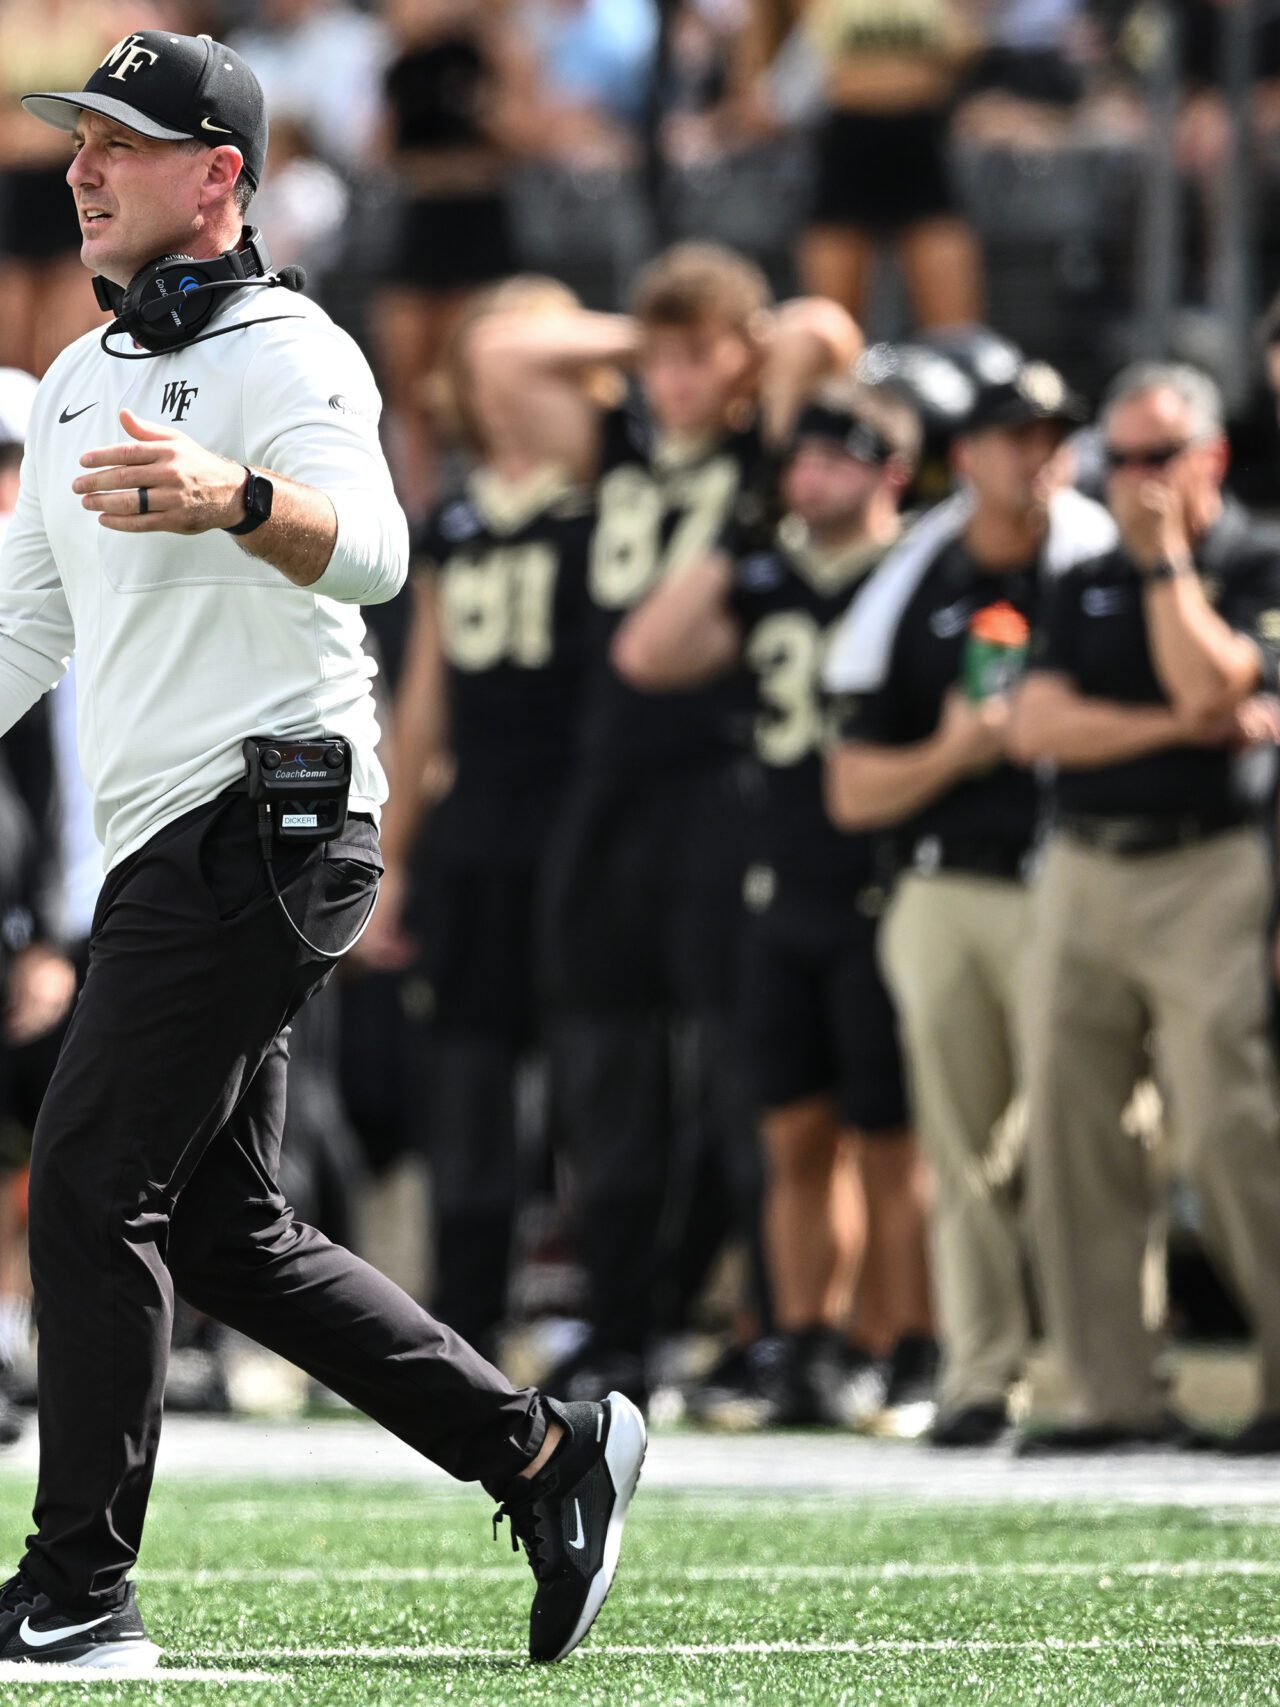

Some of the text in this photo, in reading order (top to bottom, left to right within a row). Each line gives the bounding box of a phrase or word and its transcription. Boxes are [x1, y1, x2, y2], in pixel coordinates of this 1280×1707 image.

[99, 34, 159, 82] WF
[160, 380, 199, 422] WF
[588, 457, 739, 608] 87
[748, 608, 848, 768] 3
[275, 769, 327, 779] CoachComm
[284, 816, 316, 824] DICKERT
